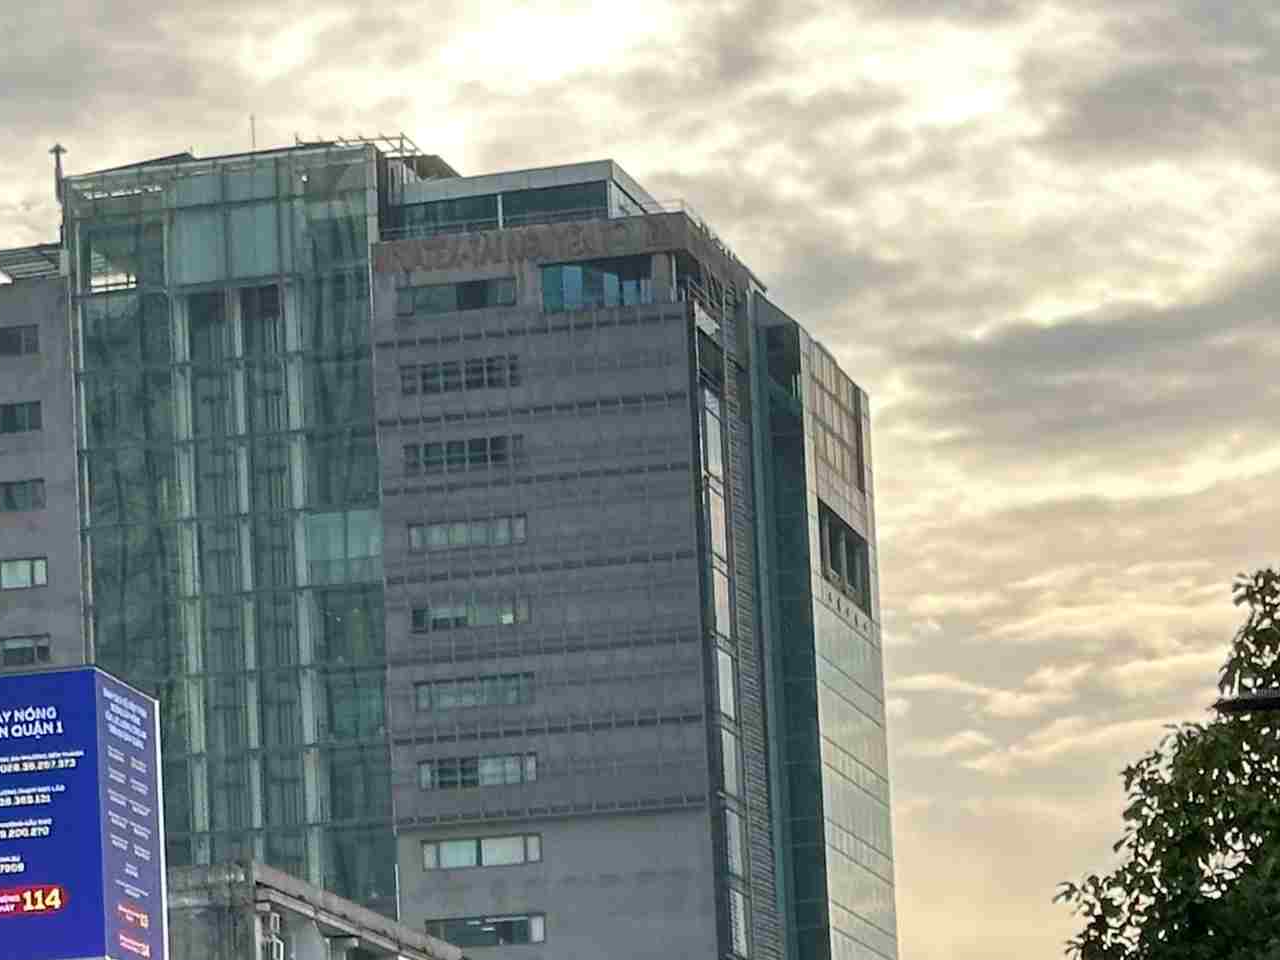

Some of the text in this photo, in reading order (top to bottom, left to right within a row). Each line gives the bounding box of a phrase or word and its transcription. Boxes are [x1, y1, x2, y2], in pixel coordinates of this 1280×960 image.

[13, 706, 57, 722] NÓNG
[11, 721, 54, 739] QUẬN
[56, 720, 64, 733] 1
[22, 887, 62, 912] 114
